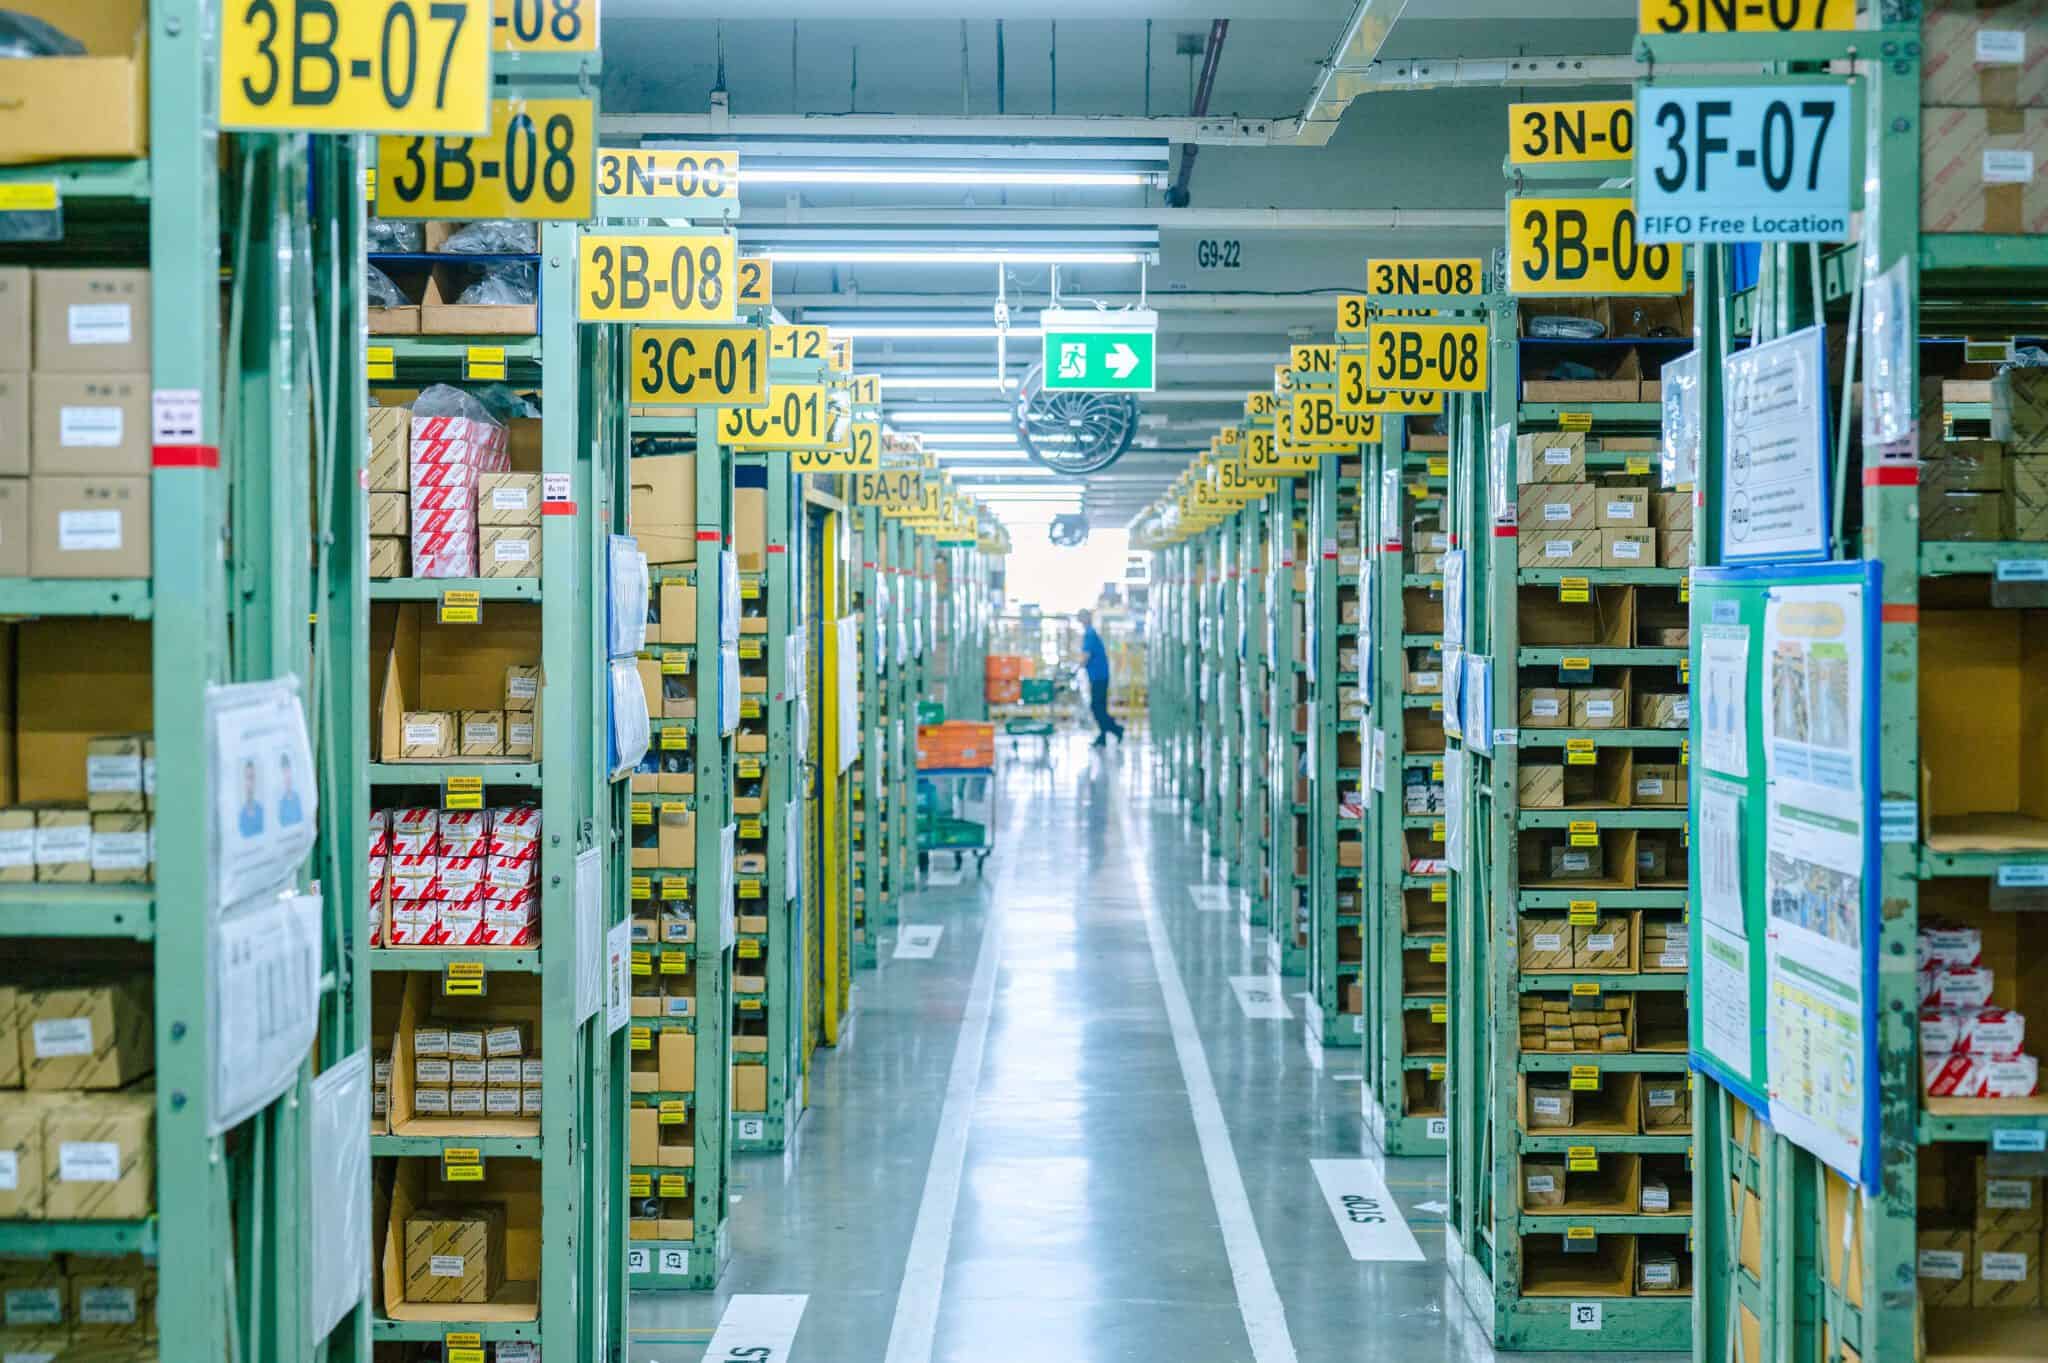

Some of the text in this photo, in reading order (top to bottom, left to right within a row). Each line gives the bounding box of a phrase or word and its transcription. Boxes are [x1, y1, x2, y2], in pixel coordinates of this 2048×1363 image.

[494, 0, 582, 42] -08
[241, 0, 468, 110] 3B-07
[1522, 109, 1633, 156] 3N-0
[1654, 101, 1835, 193] 3F-07
[393, 113, 576, 203] 3B-08
[1644, 215, 1845, 234] FIFO Free Location
[1198, 239, 1241, 268] G9-22
[591, 246, 723, 310] 3B-08
[1376, 263, 1474, 295] 3N-08
[641, 337, 757, 394] 3C-01
[774, 330, 820, 359] -12
[1377, 331, 1478, 382] 3B-08
[725, 391, 818, 437] 3C-01
[1300, 399, 1375, 436] 3B-09
[863, 473, 920, 500] 5A-01
[1341, 1195, 1387, 1224] STOP
